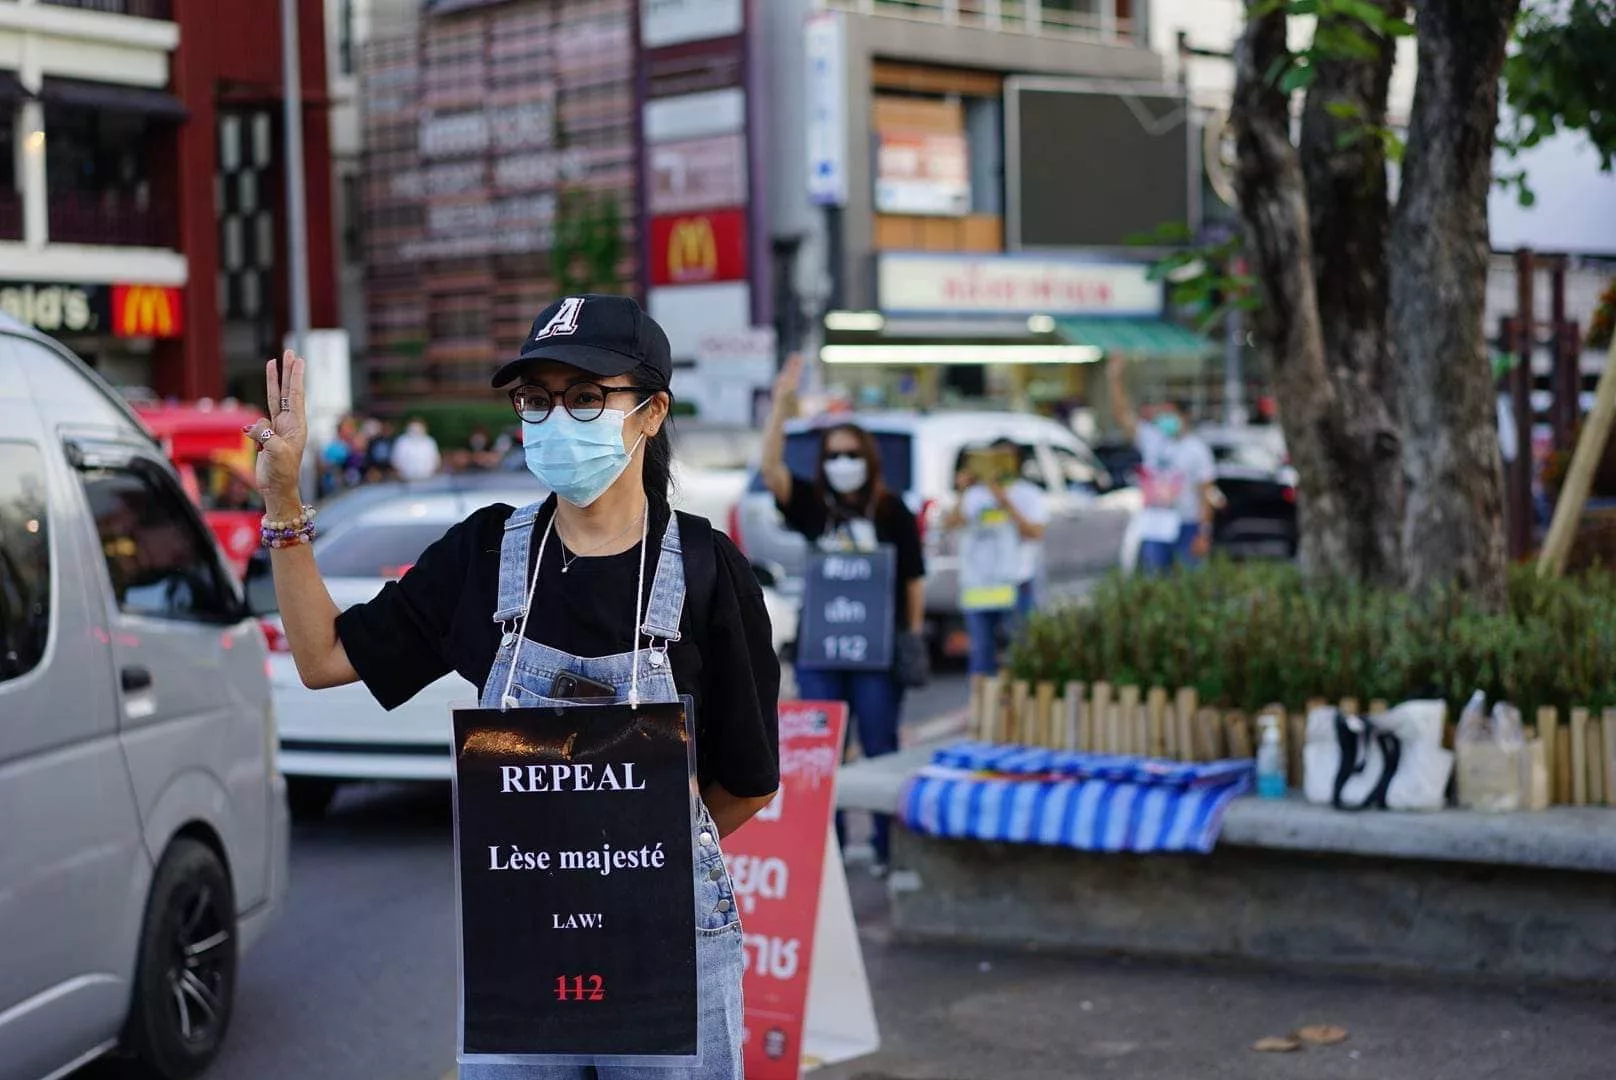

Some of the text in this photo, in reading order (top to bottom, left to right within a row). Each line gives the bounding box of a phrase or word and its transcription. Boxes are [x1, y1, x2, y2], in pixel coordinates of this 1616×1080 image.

[535, 297, 585, 341] A
[823, 635, 868, 661] 112
[500, 762, 646, 793] REPEAL
[488, 842, 665, 876] Lèse majesté
[552, 913, 603, 929] LAW!
[554, 974, 605, 1001] 112
